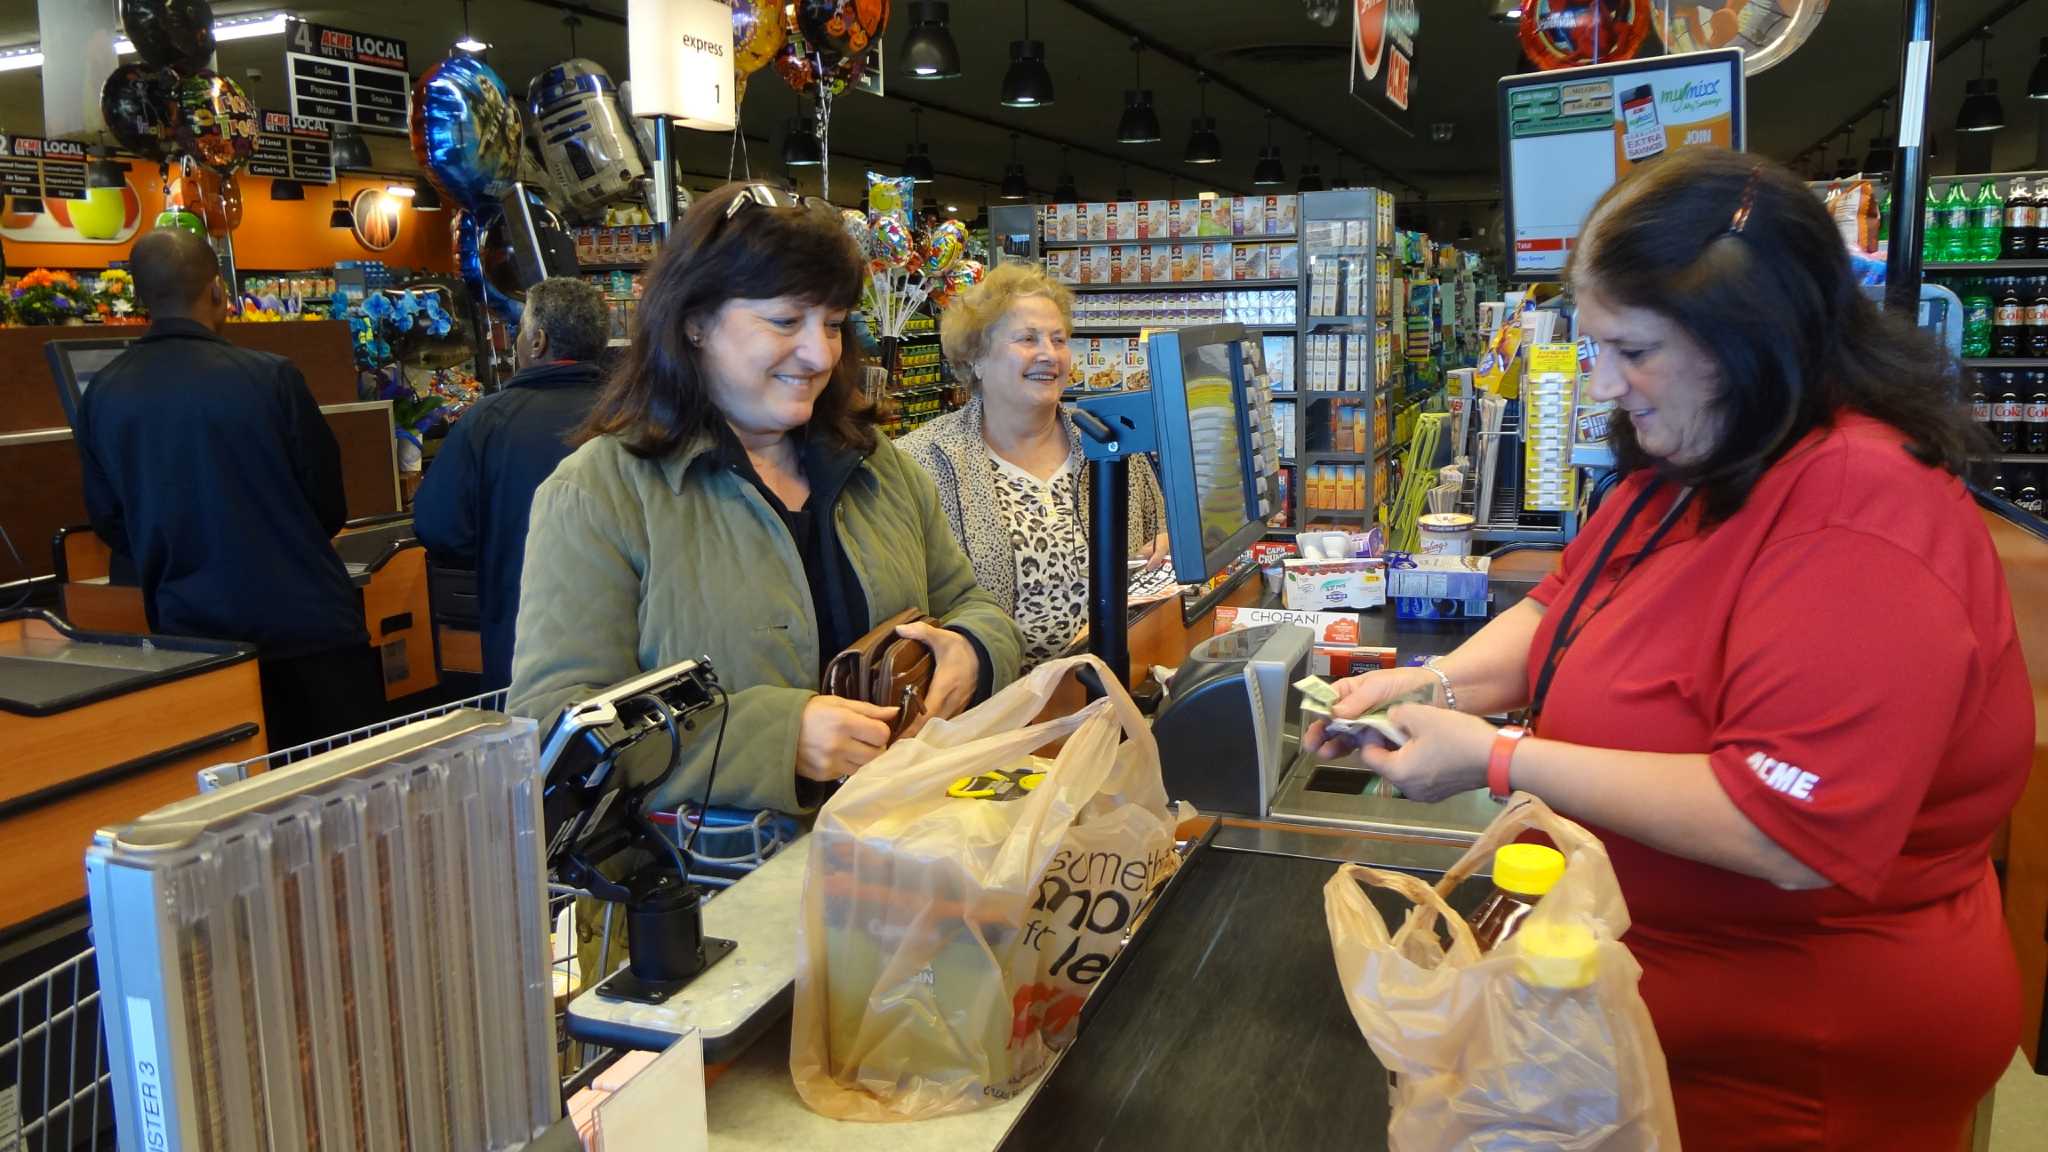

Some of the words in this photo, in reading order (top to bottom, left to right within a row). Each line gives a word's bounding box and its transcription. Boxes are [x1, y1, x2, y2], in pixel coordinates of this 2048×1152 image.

[294, 23, 312, 53] 4
[321, 30, 353, 50] ACME
[356, 36, 404, 60] LOCAL
[682, 33, 724, 57] express
[714, 83, 720, 104] 1
[293, 117, 329, 132] LOCAL
[44, 141, 84, 155] LOCAL
[1087, 352, 1106, 366] life
[1125, 352, 1145, 366] life
[2027, 406, 2048, 418] Cok
[1250, 610, 1320, 624] CHOBANI
[1746, 752, 1820, 801] ACME
[1049, 936, 1112, 984] le
[138, 1060, 155, 1077] 3
[141, 1082, 167, 1152] ISTER
